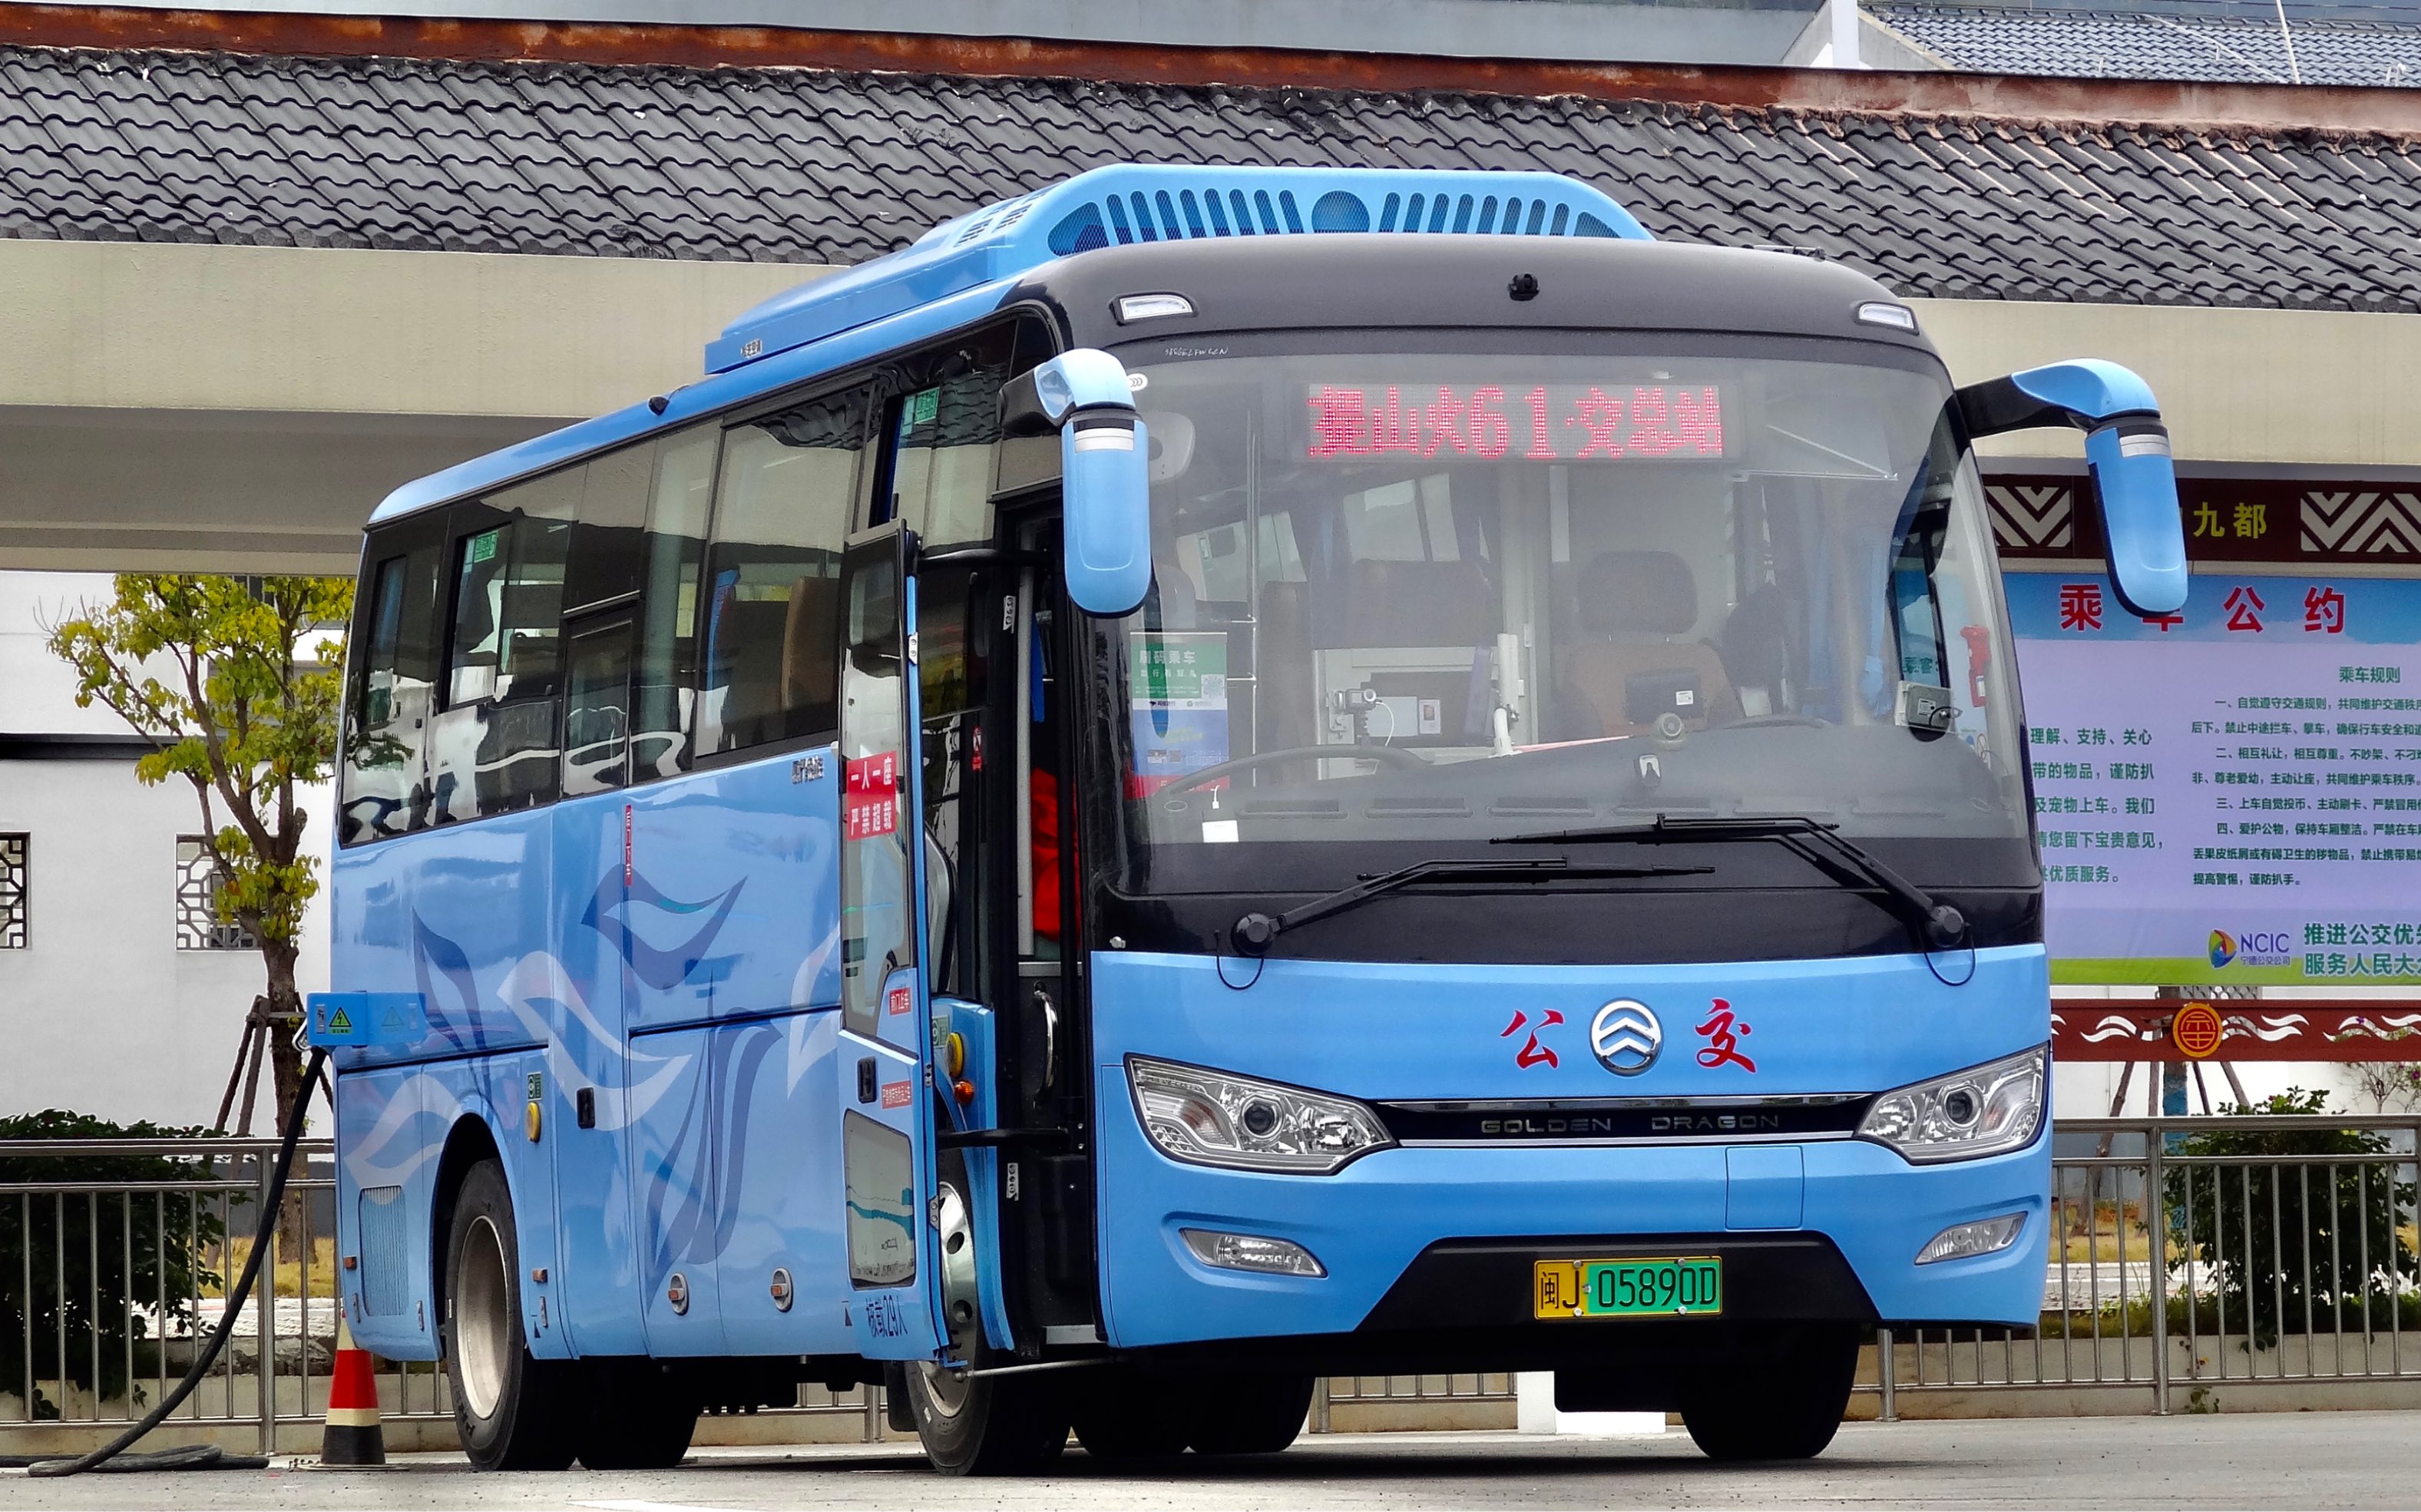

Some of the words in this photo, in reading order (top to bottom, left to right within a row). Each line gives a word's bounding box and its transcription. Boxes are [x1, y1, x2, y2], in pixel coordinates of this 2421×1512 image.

[2193, 501, 2267, 539] 九都
[2339, 667, 2400, 683] 乘车规则
[2030, 728, 2152, 746] 理解、支持、关心
[851, 756, 892, 790] 一人一座
[851, 800, 892, 836] 严禁超载
[2240, 933, 2290, 954] NCIC
[2304, 923, 2421, 946] 推进公交优
[2240, 955, 2290, 966] 宁德公交公司
[2305, 952, 2421, 975] 服务人民大
[1500, 1008, 1565, 1069] 公
[1695, 998, 1757, 1074] 交
[1480, 1117, 1612, 1134] GOLDEN
[1651, 1114, 1779, 1130] DRAGON
